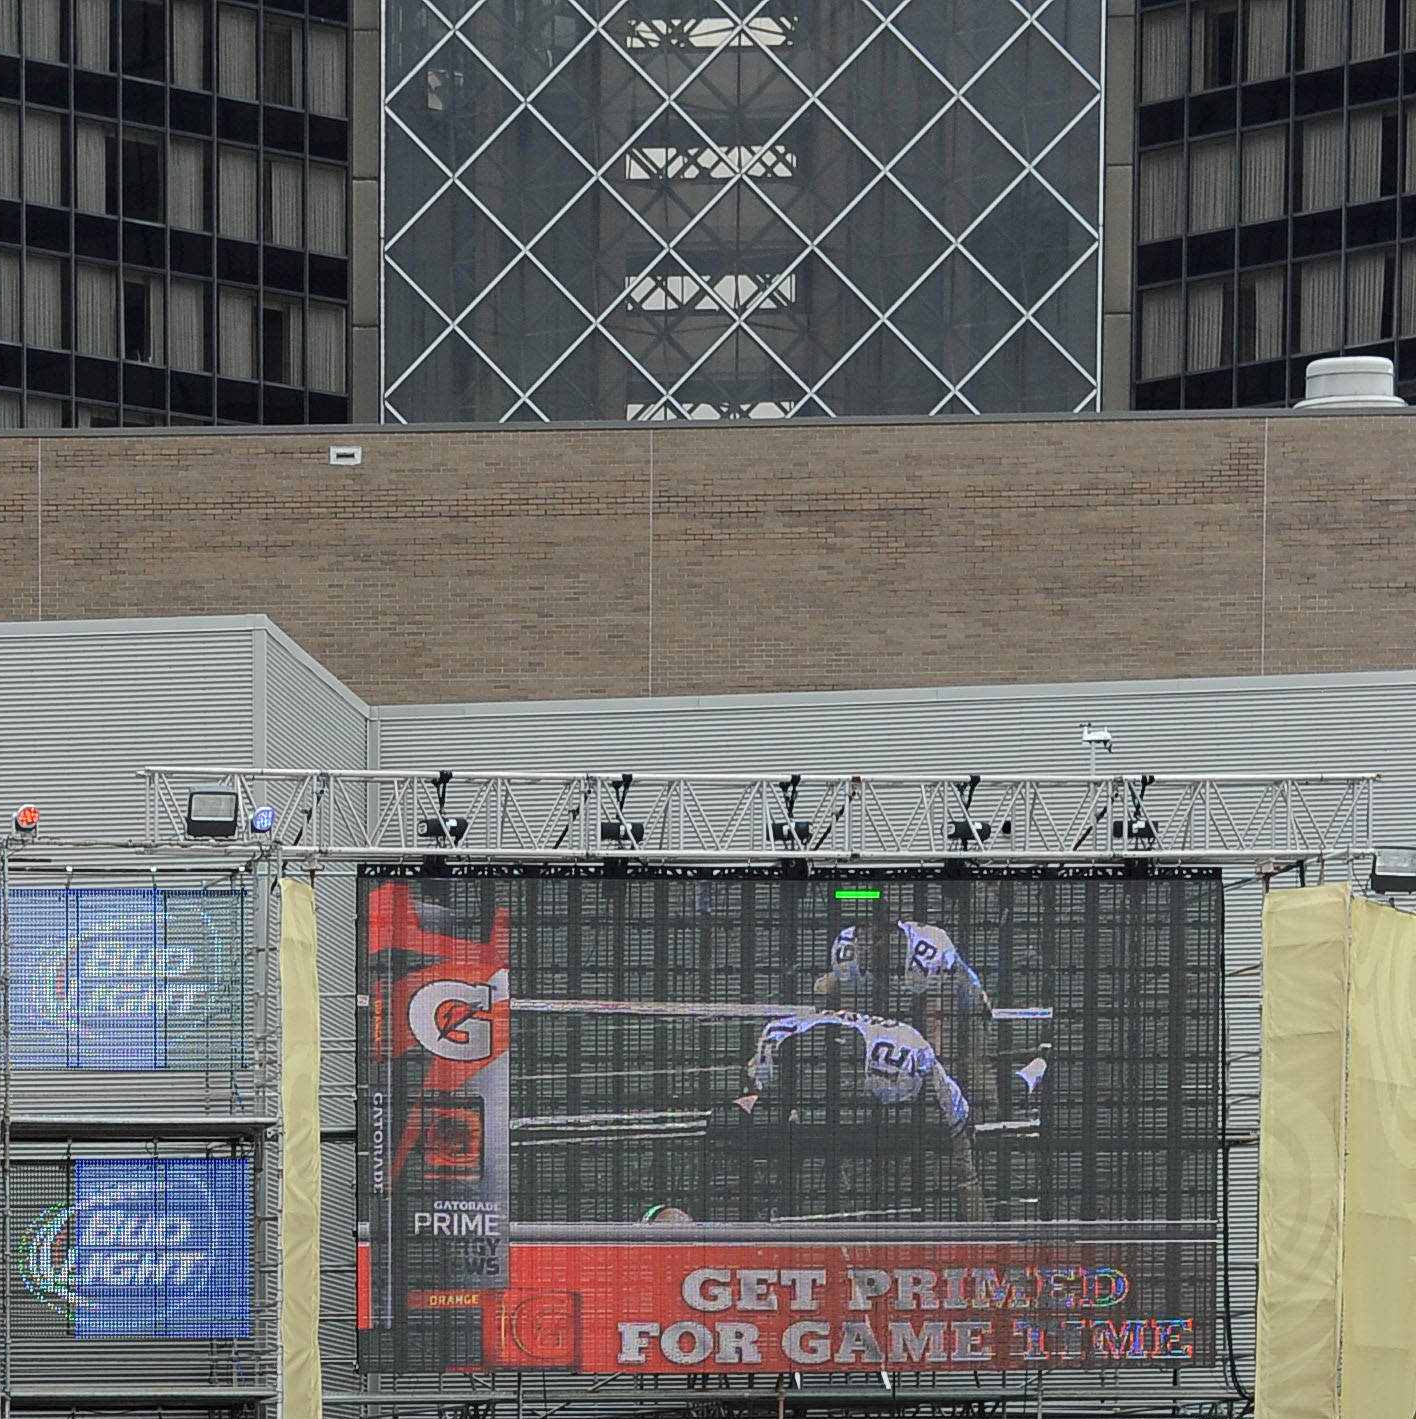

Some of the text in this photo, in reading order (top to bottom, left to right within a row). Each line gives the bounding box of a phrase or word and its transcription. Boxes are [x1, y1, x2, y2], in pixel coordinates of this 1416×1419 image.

[83, 941, 193, 977] BUD
[373, 1091, 384, 1195] GATORADE
[82, 1209, 189, 1246] BUD
[415, 1213, 500, 1236] PRIME
[64, 1251, 208, 1286] LIGHT
[430, 1294, 479, 1305] ORANGE
[681, 1265, 1131, 1312] GET PRIMED
[619, 1315, 1195, 1365] FOR GAME TIME
